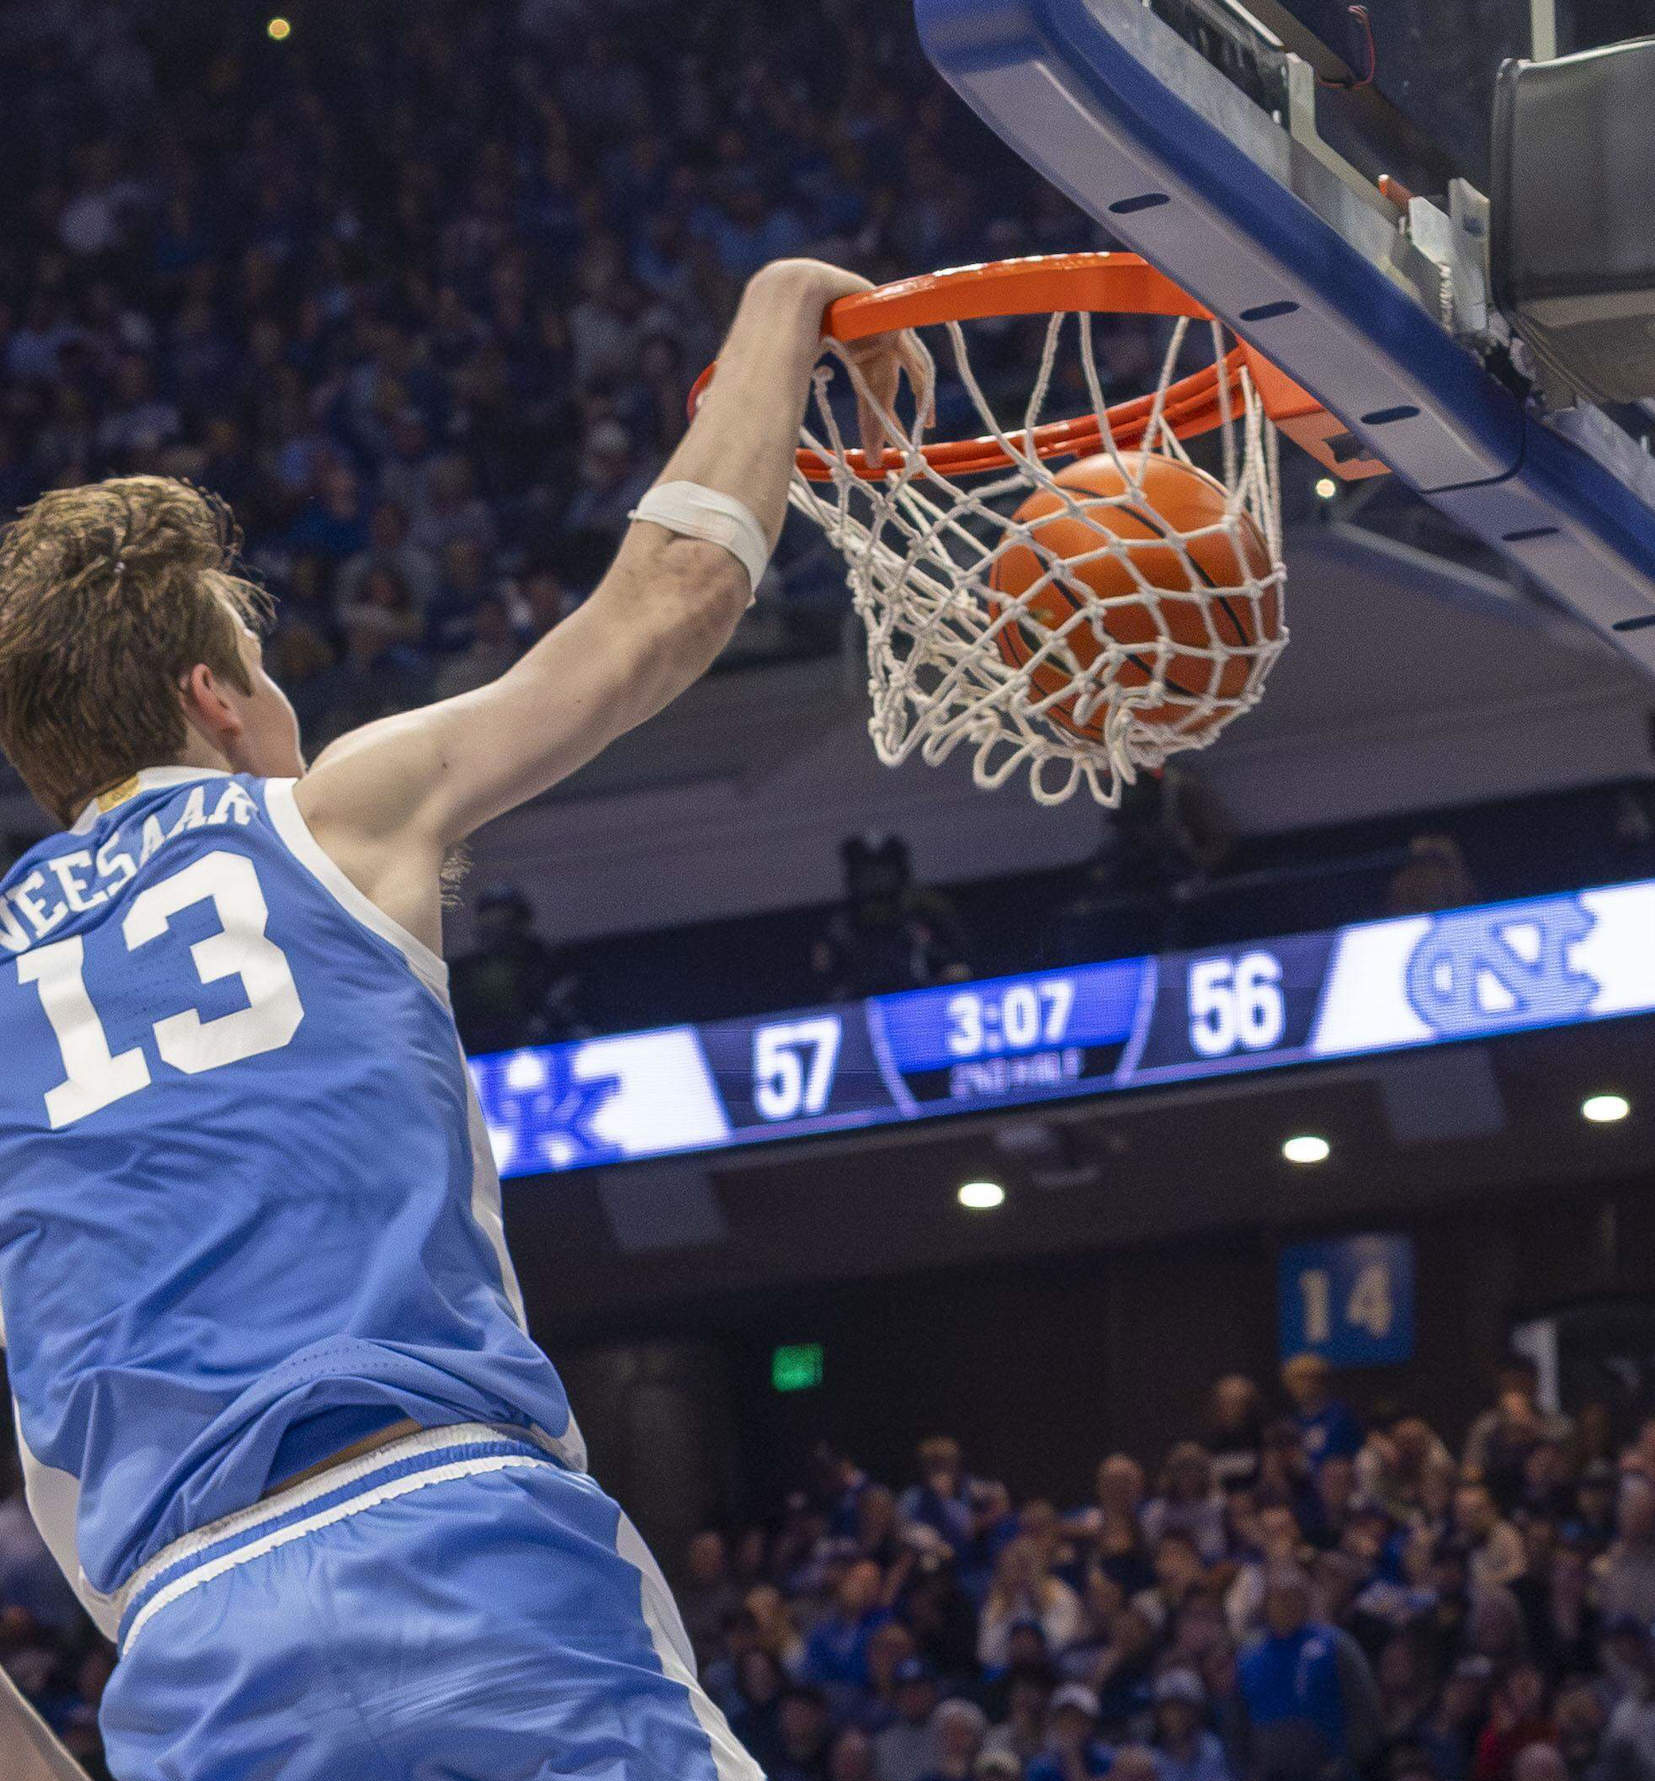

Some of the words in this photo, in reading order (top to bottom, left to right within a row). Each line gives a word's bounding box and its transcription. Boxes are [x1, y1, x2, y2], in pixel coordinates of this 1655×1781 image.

[16, 849, 305, 1131] 13
[752, 1013, 843, 1120] 57
[946, 979, 1076, 1058] 3:07
[1186, 950, 1285, 1058] 56
[1299, 1264, 1394, 1340] 14
